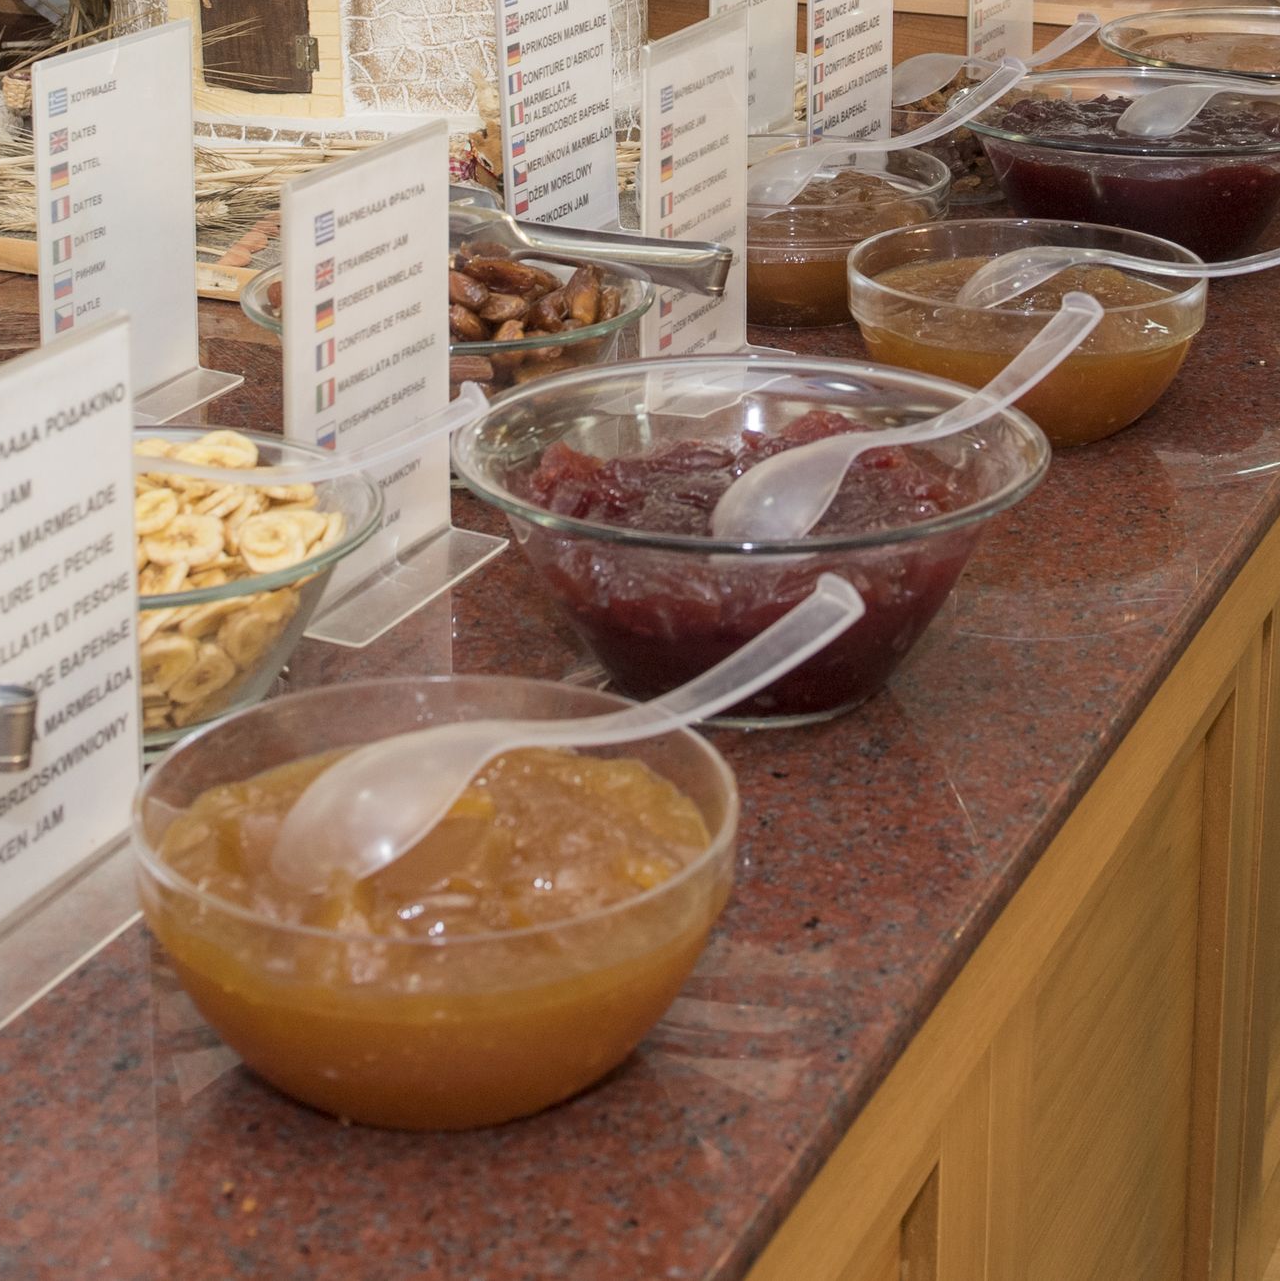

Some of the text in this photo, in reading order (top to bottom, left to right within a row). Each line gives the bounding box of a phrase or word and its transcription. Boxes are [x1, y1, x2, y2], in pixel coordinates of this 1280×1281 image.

[519, 0, 569, 29] APRICOT JAM
[825, 3, 847, 22] QUINCE
[520, 14, 607, 57] APRIKOSEN MARMELADE
[825, 15, 880, 49] QUITTE MARMELADE
[521, 59, 565, 88] CONFITURE
[824, 52, 856, 77] CONFITURE
[857, 48, 865, 61] DE
[522, 80, 571, 110] MARMELLATA
[824, 79, 858, 104] MARMELLATA
[857, 76, 864, 87] DI
[524, 93, 577, 125] DI ALBICOCCHE
[695, 114, 706, 127] JAM
[71, 124, 96, 142] DATES
[849, 119, 881, 138] ARMELÁDA
[72, 157, 101, 175] DATTEL
[550, 162, 592, 192] MORELOWY
[73, 194, 103, 214] DATTES
[574, 193, 589, 211] JAM
[74, 226, 106, 247] DATTERI
[337, 234, 408, 275] STRAWBERRY JAM
[337, 262, 423, 312] ERDBEER MARMELADE
[76, 297, 100, 317] DATLE
[337, 302, 421, 352] CONFITURE DE FRAISE
[337, 333, 435, 393] MARMELLATA DI FRAGOLE
[19, 484, 115, 552] MARMELADE
[383, 508, 400, 527] JAM
[38, 564, 59, 593] DE
[64, 533, 113, 576] PECHE
[54, 609, 70, 633] DI
[73, 572, 129, 620] PESCHE
[32, 805, 64, 842] JAM
